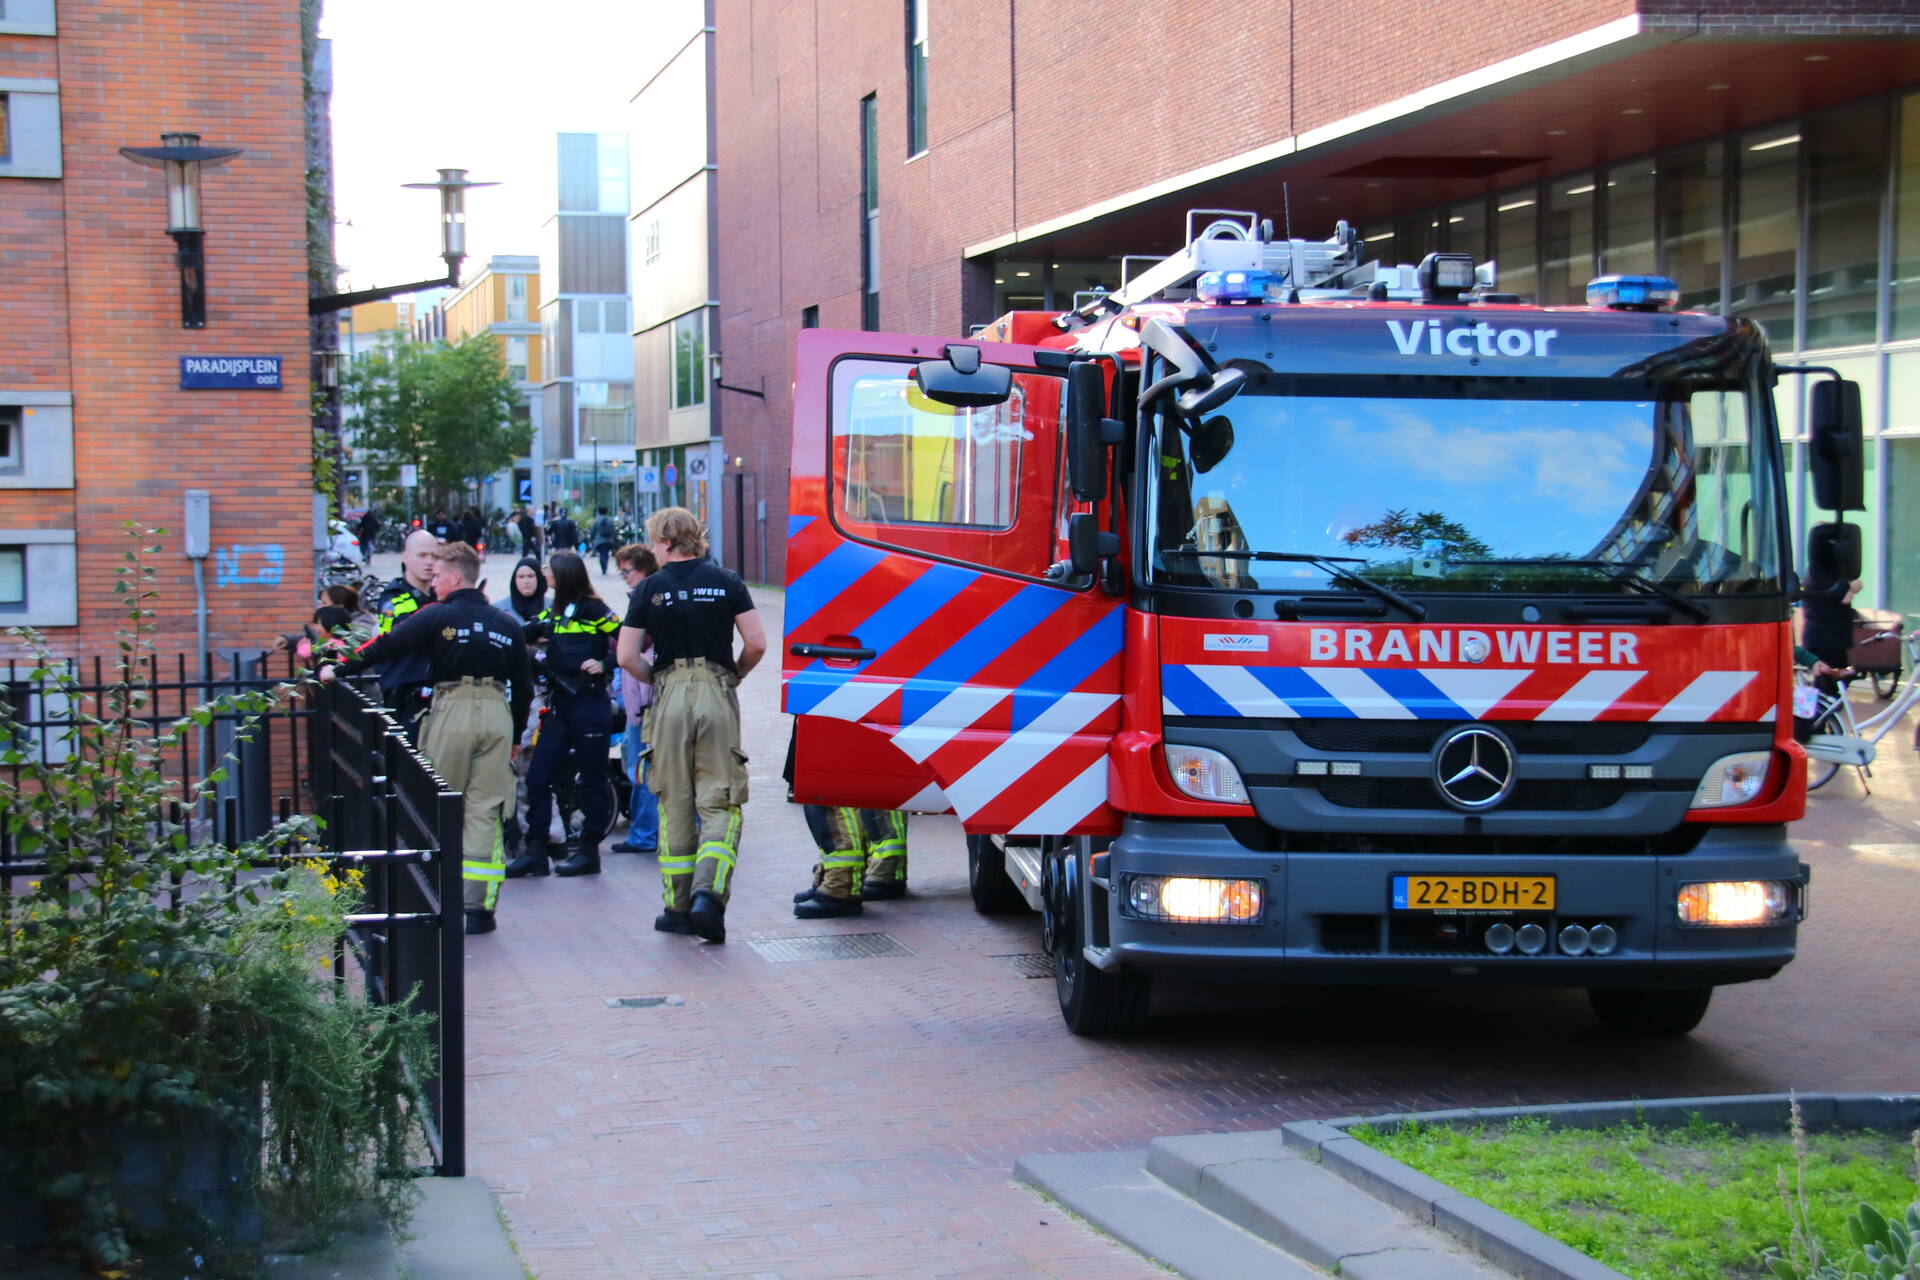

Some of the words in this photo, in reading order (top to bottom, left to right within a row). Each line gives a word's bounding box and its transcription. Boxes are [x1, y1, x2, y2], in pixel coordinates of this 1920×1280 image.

[1386, 319, 1557, 357] Victor
[186, 359, 278, 376] PARADIJSPLEIN
[256, 376, 278, 385] OOST
[1310, 628, 1638, 664] BRANDWEER
[1394, 895, 1405, 904] NL
[1416, 880, 1547, 905] 22-BDH-2
